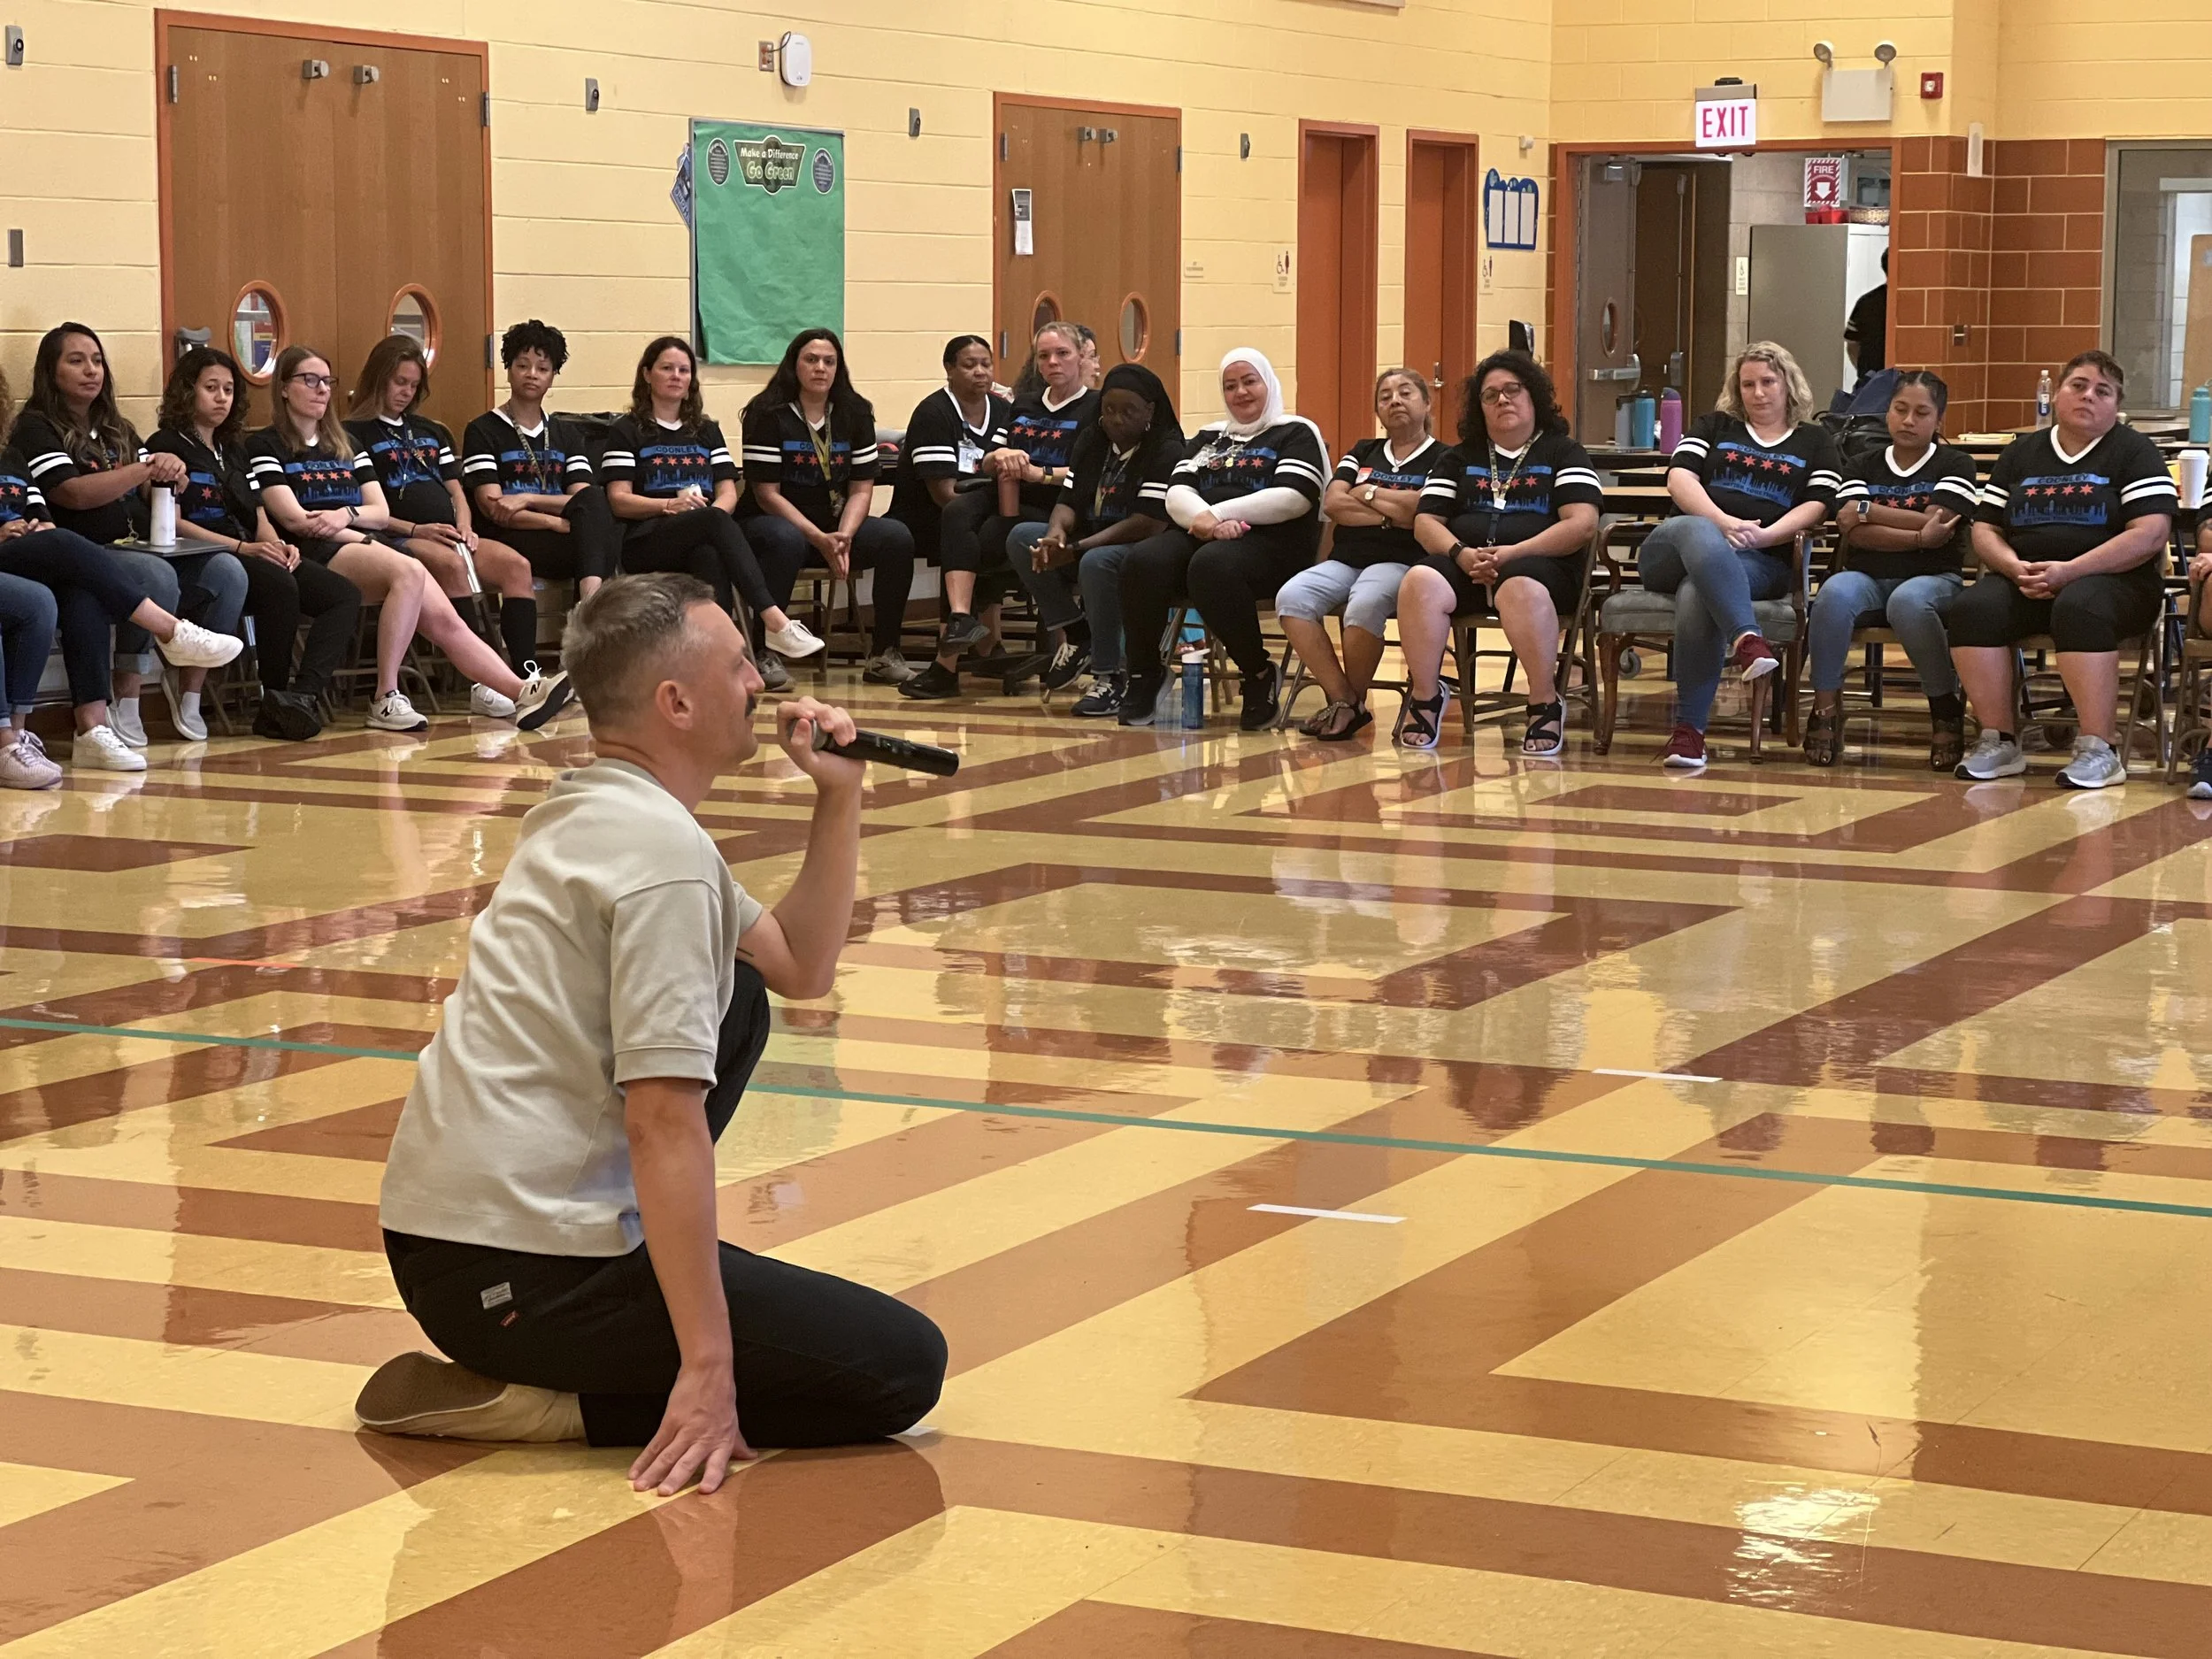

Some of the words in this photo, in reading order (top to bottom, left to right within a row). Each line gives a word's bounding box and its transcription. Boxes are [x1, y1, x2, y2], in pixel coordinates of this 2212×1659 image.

[1702, 106, 1748, 138] EXIT
[741, 147, 761, 157] Make
[767, 149, 799, 160] Difference
[747, 160, 764, 180] Go
[764, 161, 795, 180] Green
[1814, 165, 1834, 174] FIRE
[1736, 445, 1786, 460] COONLEY
[1372, 471, 1414, 482] OONLEY
[2038, 473, 2089, 484] COONLEY
[1878, 482, 1926, 495] COONLEY
